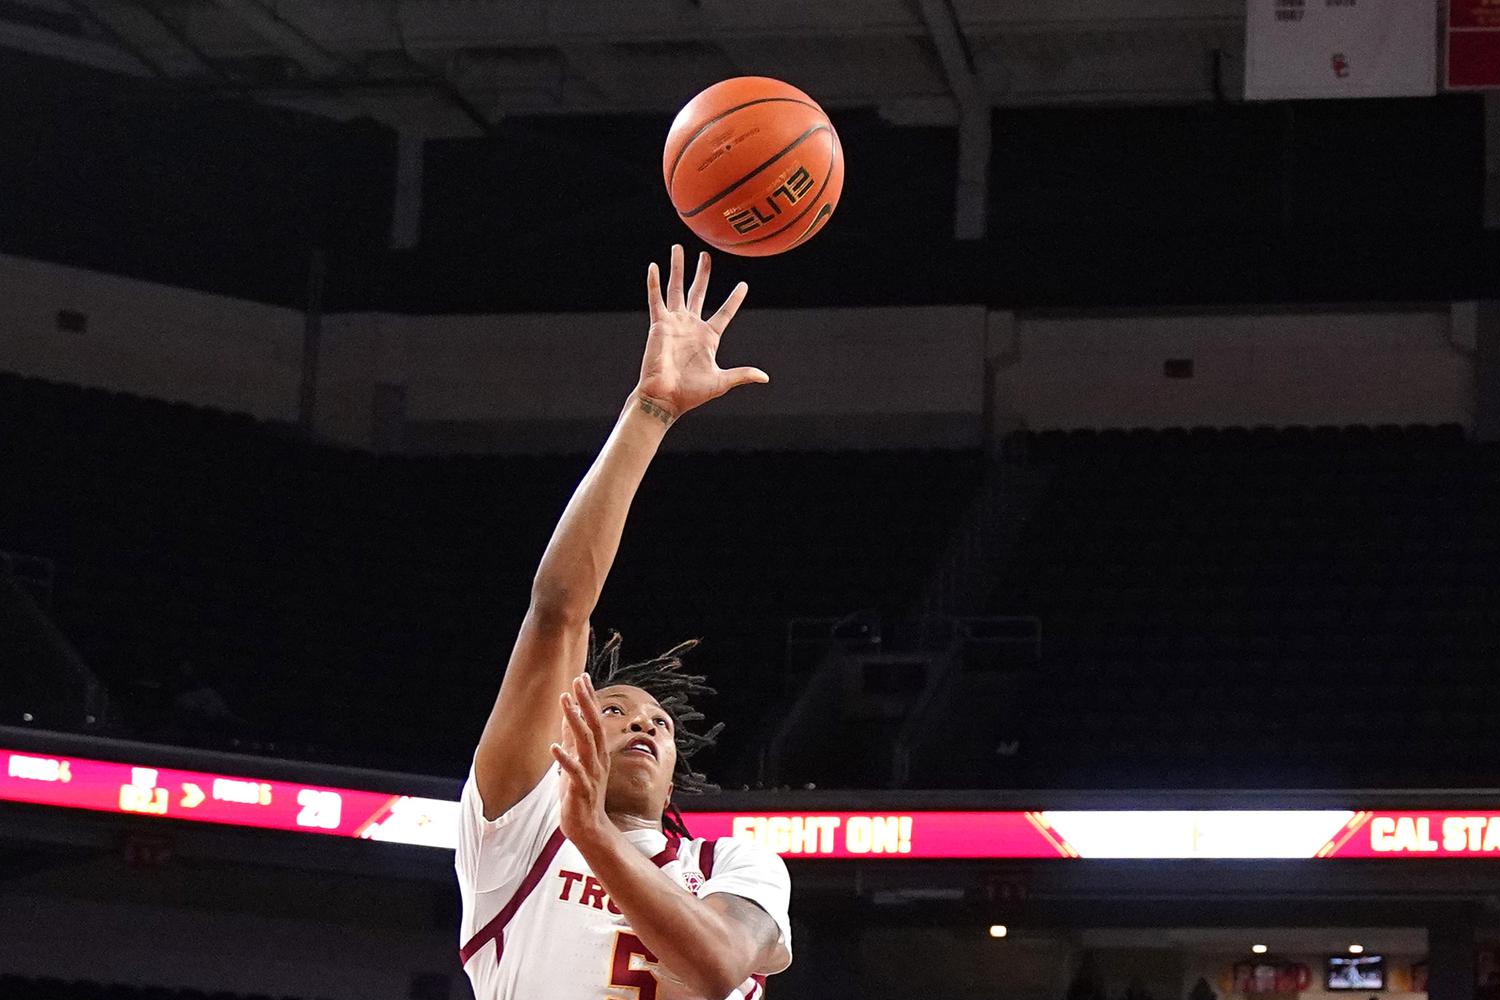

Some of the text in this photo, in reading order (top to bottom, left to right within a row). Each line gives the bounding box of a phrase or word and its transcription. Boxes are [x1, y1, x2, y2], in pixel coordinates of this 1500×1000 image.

[727, 166, 815, 235] ELITE
[732, 816, 913, 853] FIGHT ON!
[1370, 816, 1438, 852] CAL
